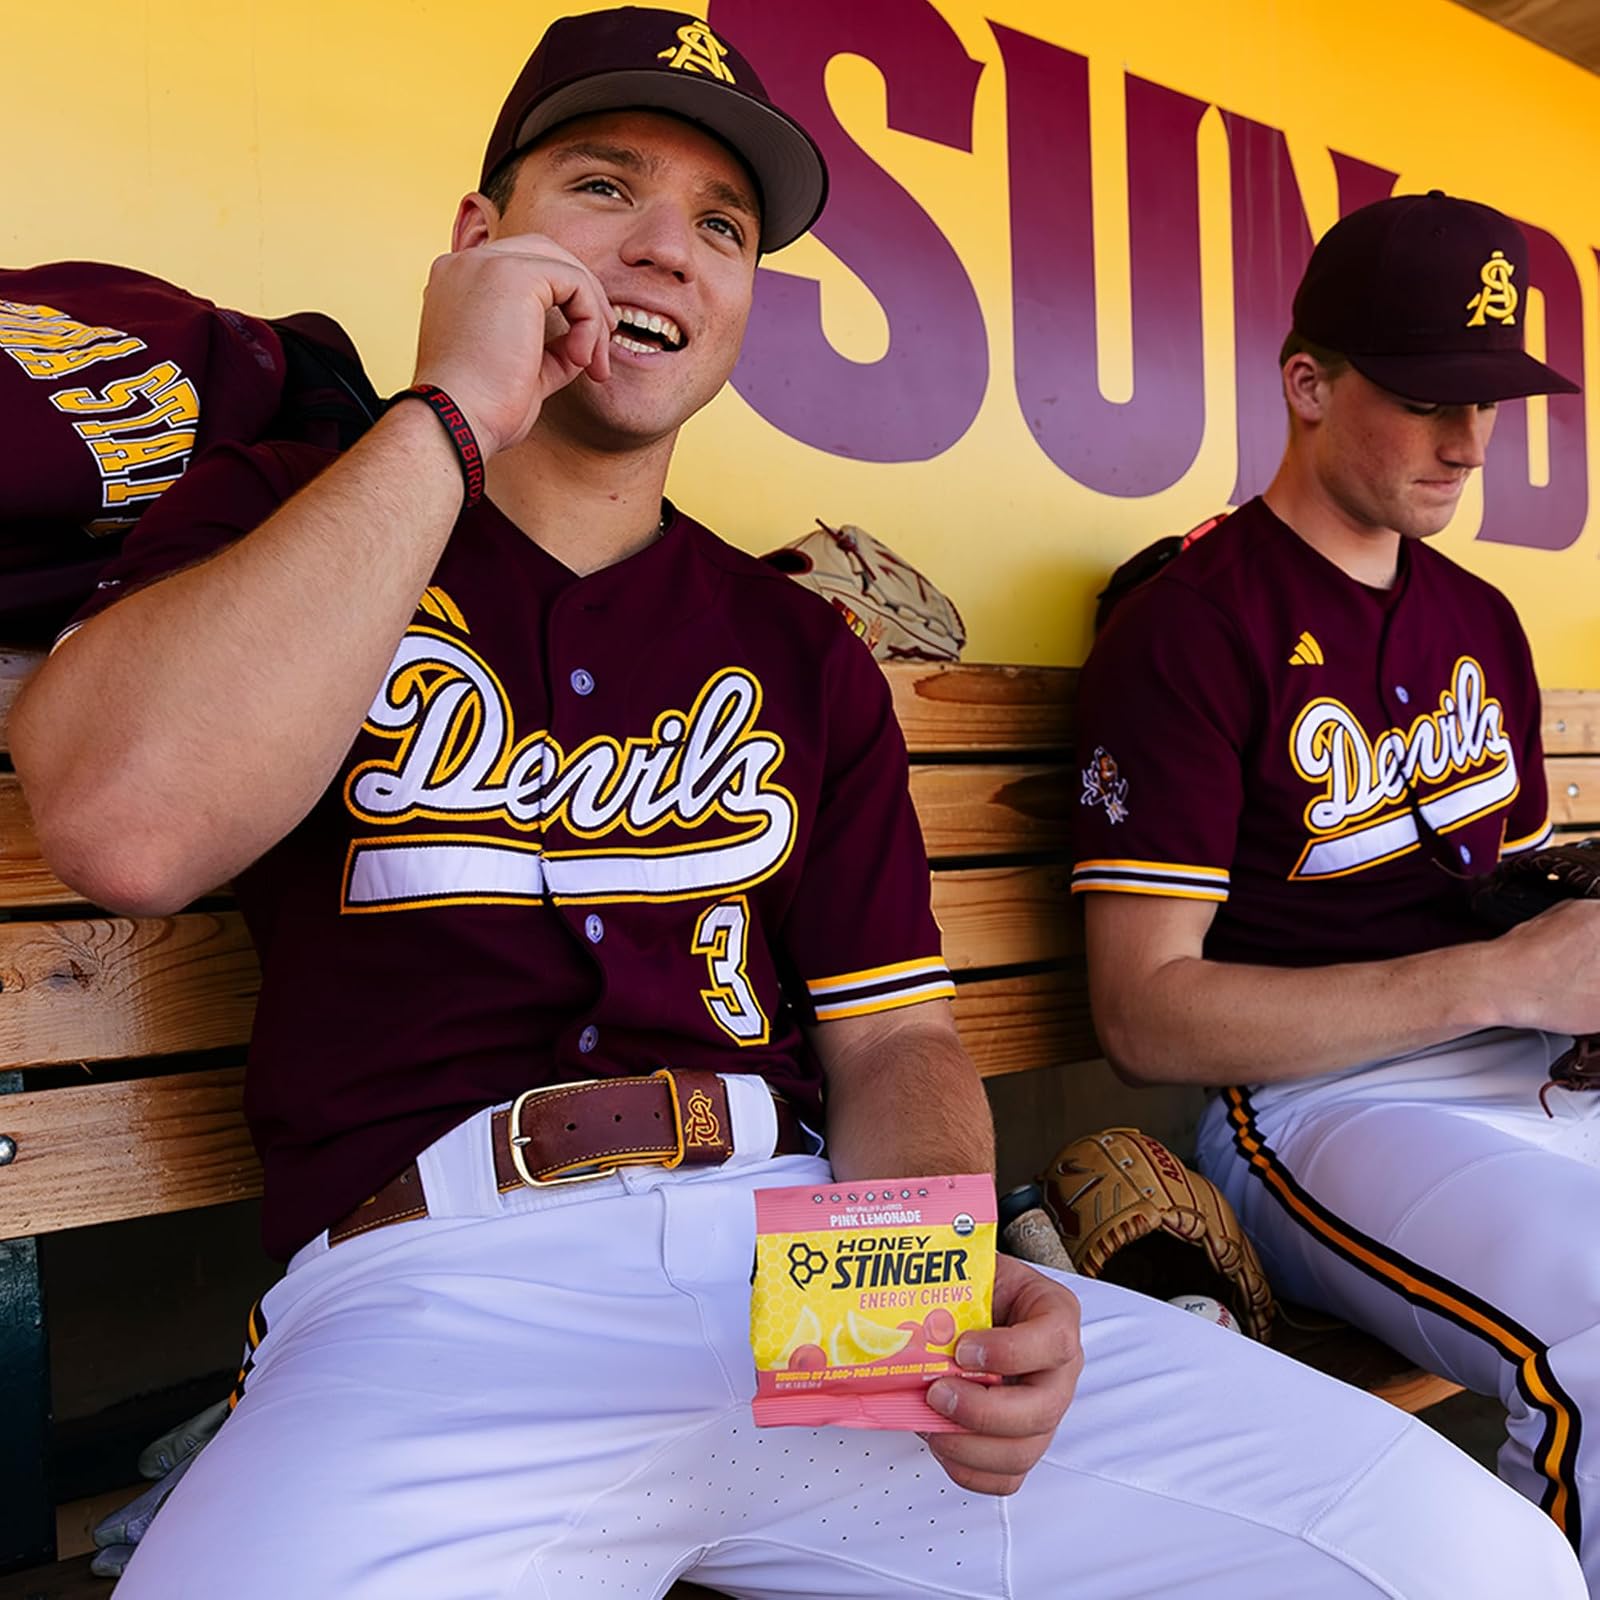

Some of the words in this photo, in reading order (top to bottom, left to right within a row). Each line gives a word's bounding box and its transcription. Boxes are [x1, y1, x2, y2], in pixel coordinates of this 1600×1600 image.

[48, 360, 201, 538] STAT
[1475, 212, 1600, 551] D
[343, 625, 798, 915] Devils
[1288, 655, 1520, 881] Devils
[691, 893, 770, 1047] 3
[830, 1214, 860, 1228] PINK
[860, 1210, 922, 1226] LEMONADE
[831, 1248, 968, 1290] STINGER
[836, 1235, 931, 1254] HONEY
[860, 1290, 916, 1310] ENERGY
[920, 1286, 973, 1306] CHEWS
